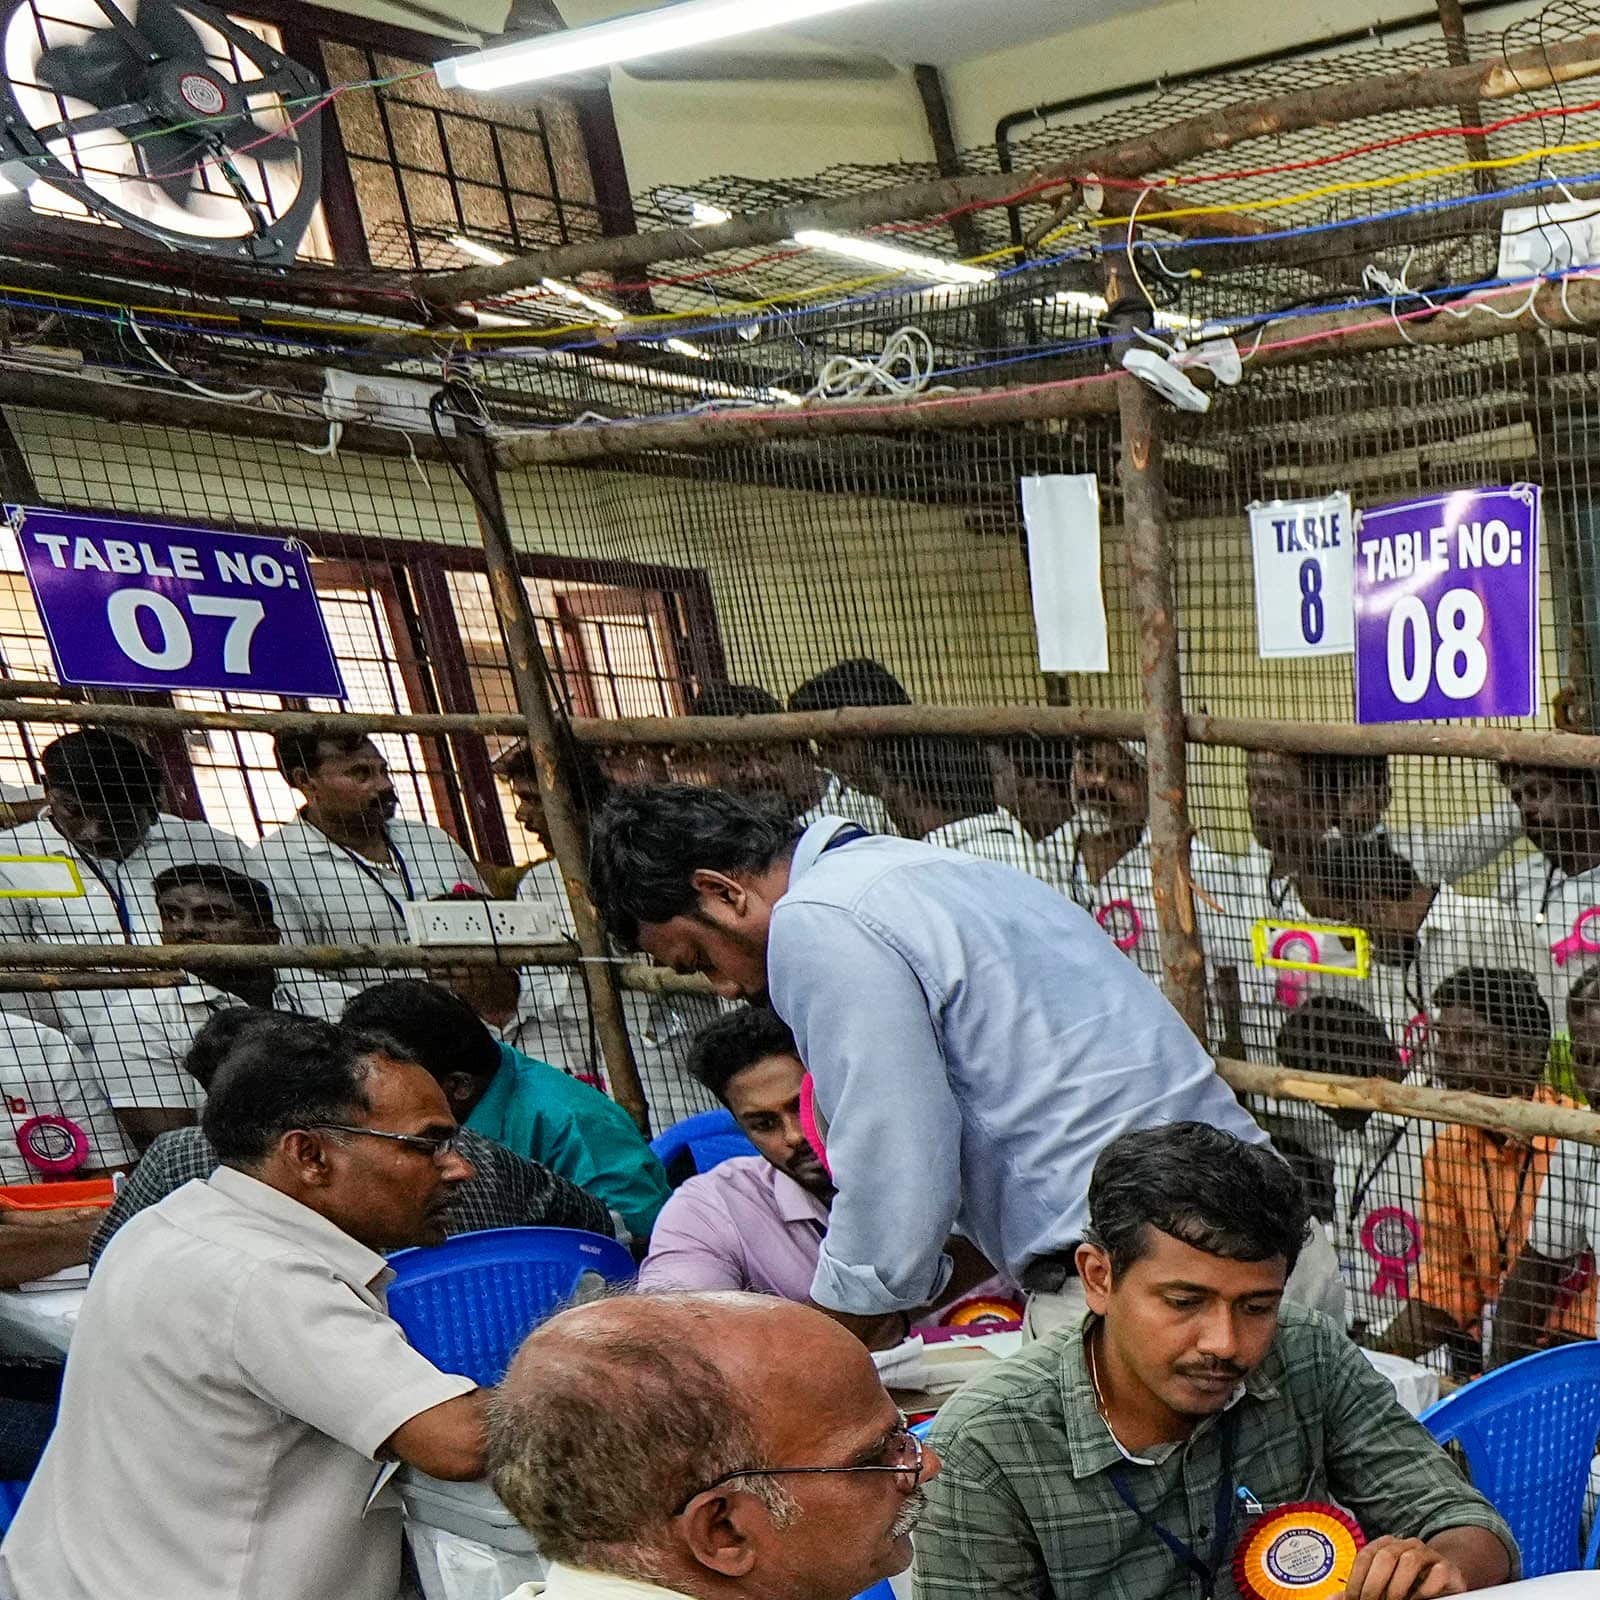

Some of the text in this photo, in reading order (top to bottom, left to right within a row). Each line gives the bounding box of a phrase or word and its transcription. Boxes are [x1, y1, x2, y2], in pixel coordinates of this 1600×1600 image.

[34, 533, 301, 590] TABLE NO:
[1272, 512, 1342, 554] TABLE
[1362, 519, 1523, 584] TABLE NO:
[107, 588, 266, 675] 07
[1299, 557, 1325, 645] 8
[1387, 587, 1489, 704] 08
